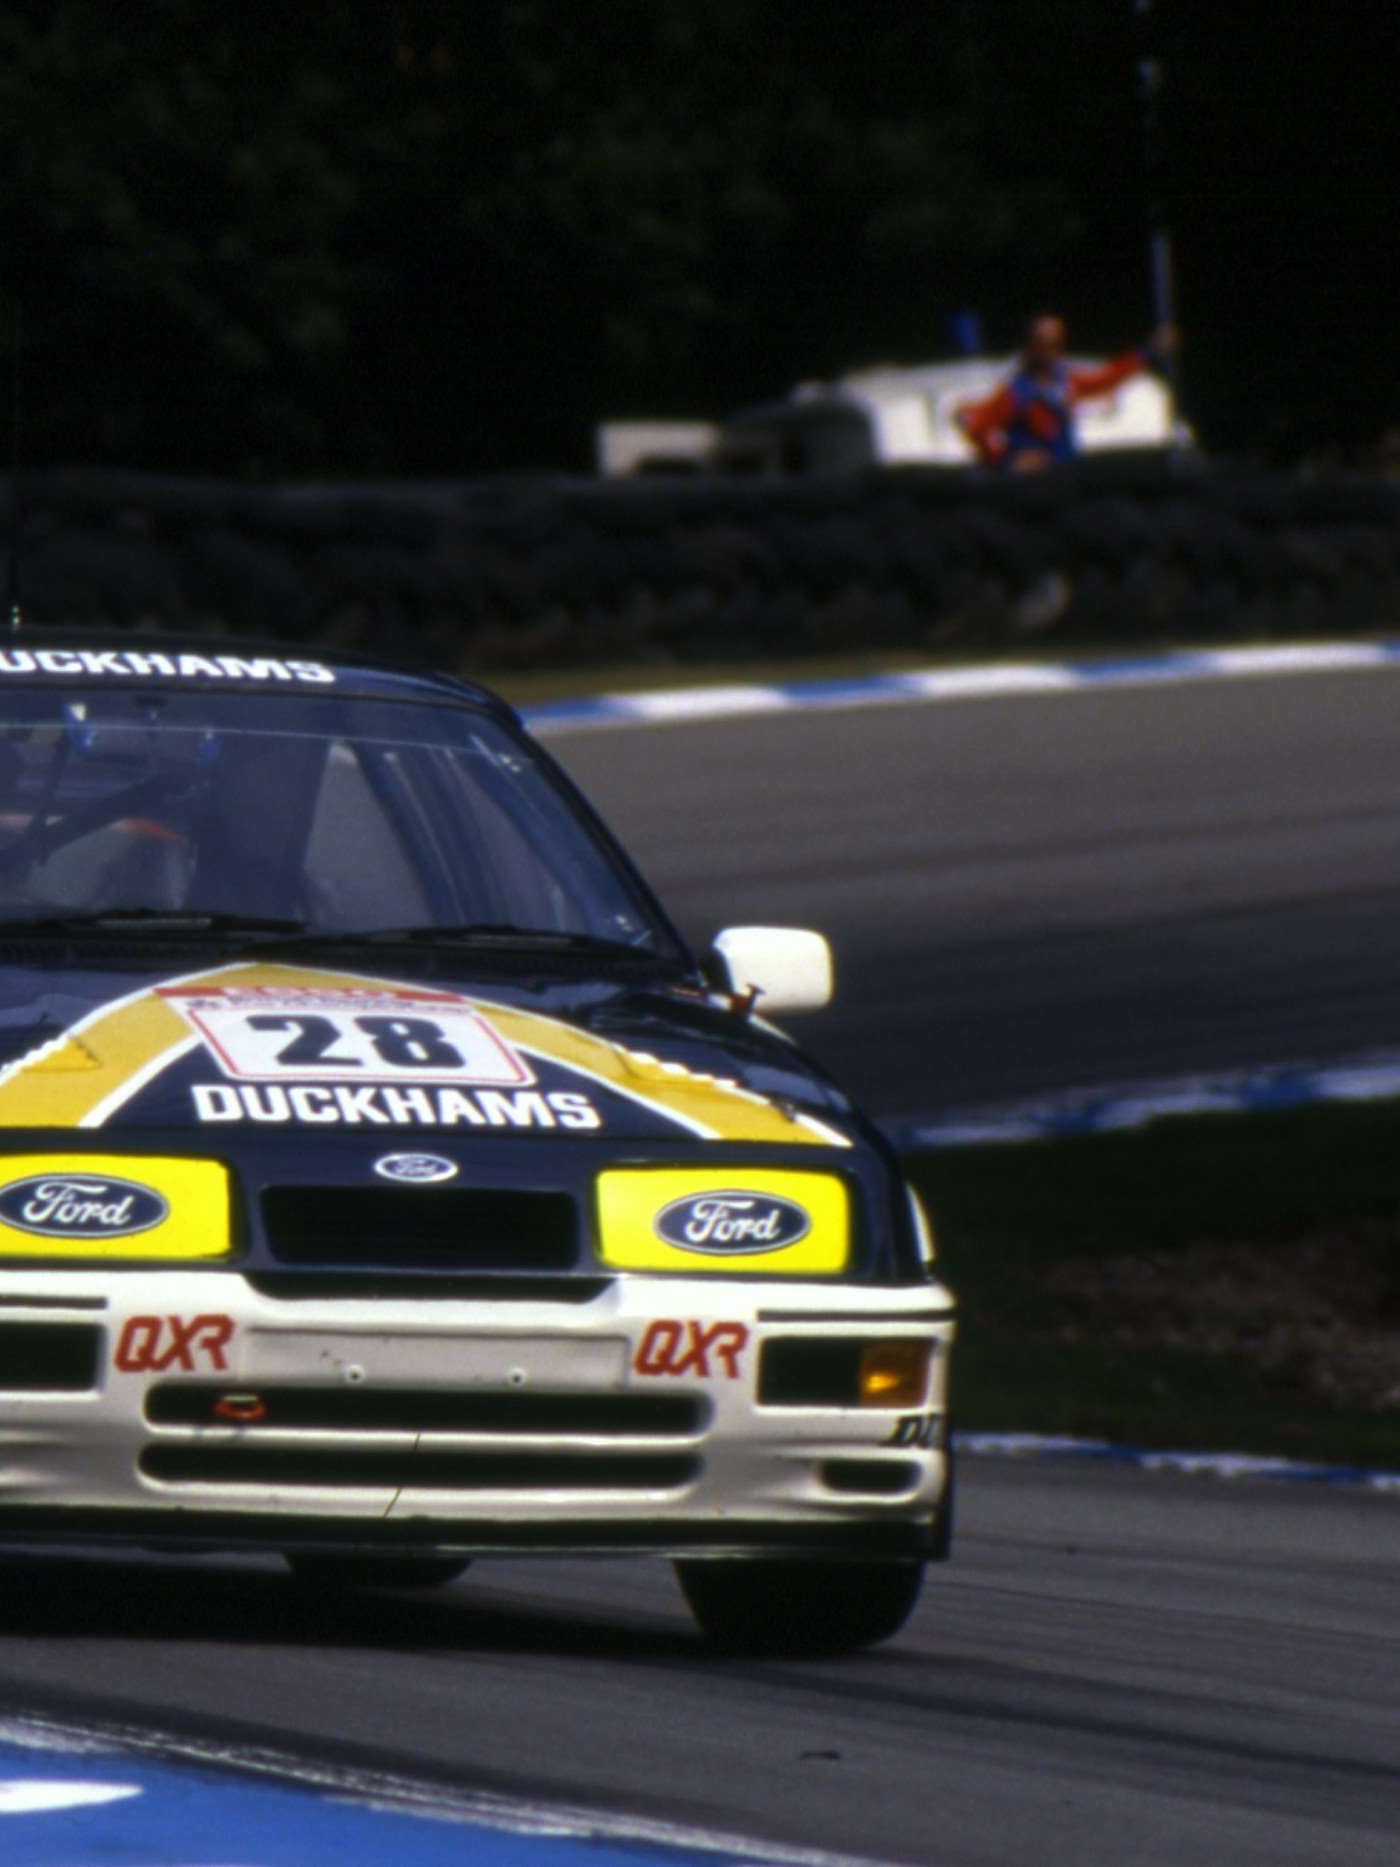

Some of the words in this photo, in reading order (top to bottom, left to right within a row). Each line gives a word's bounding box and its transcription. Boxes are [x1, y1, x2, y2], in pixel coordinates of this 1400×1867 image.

[244, 1014, 466, 1069] 28
[191, 1084, 602, 1129] DUCKHAMS
[22, 1181, 135, 1225] Ford
[684, 1199, 781, 1243] Ford
[113, 1313, 235, 1373] QXR
[634, 1319, 749, 1379] QXR
